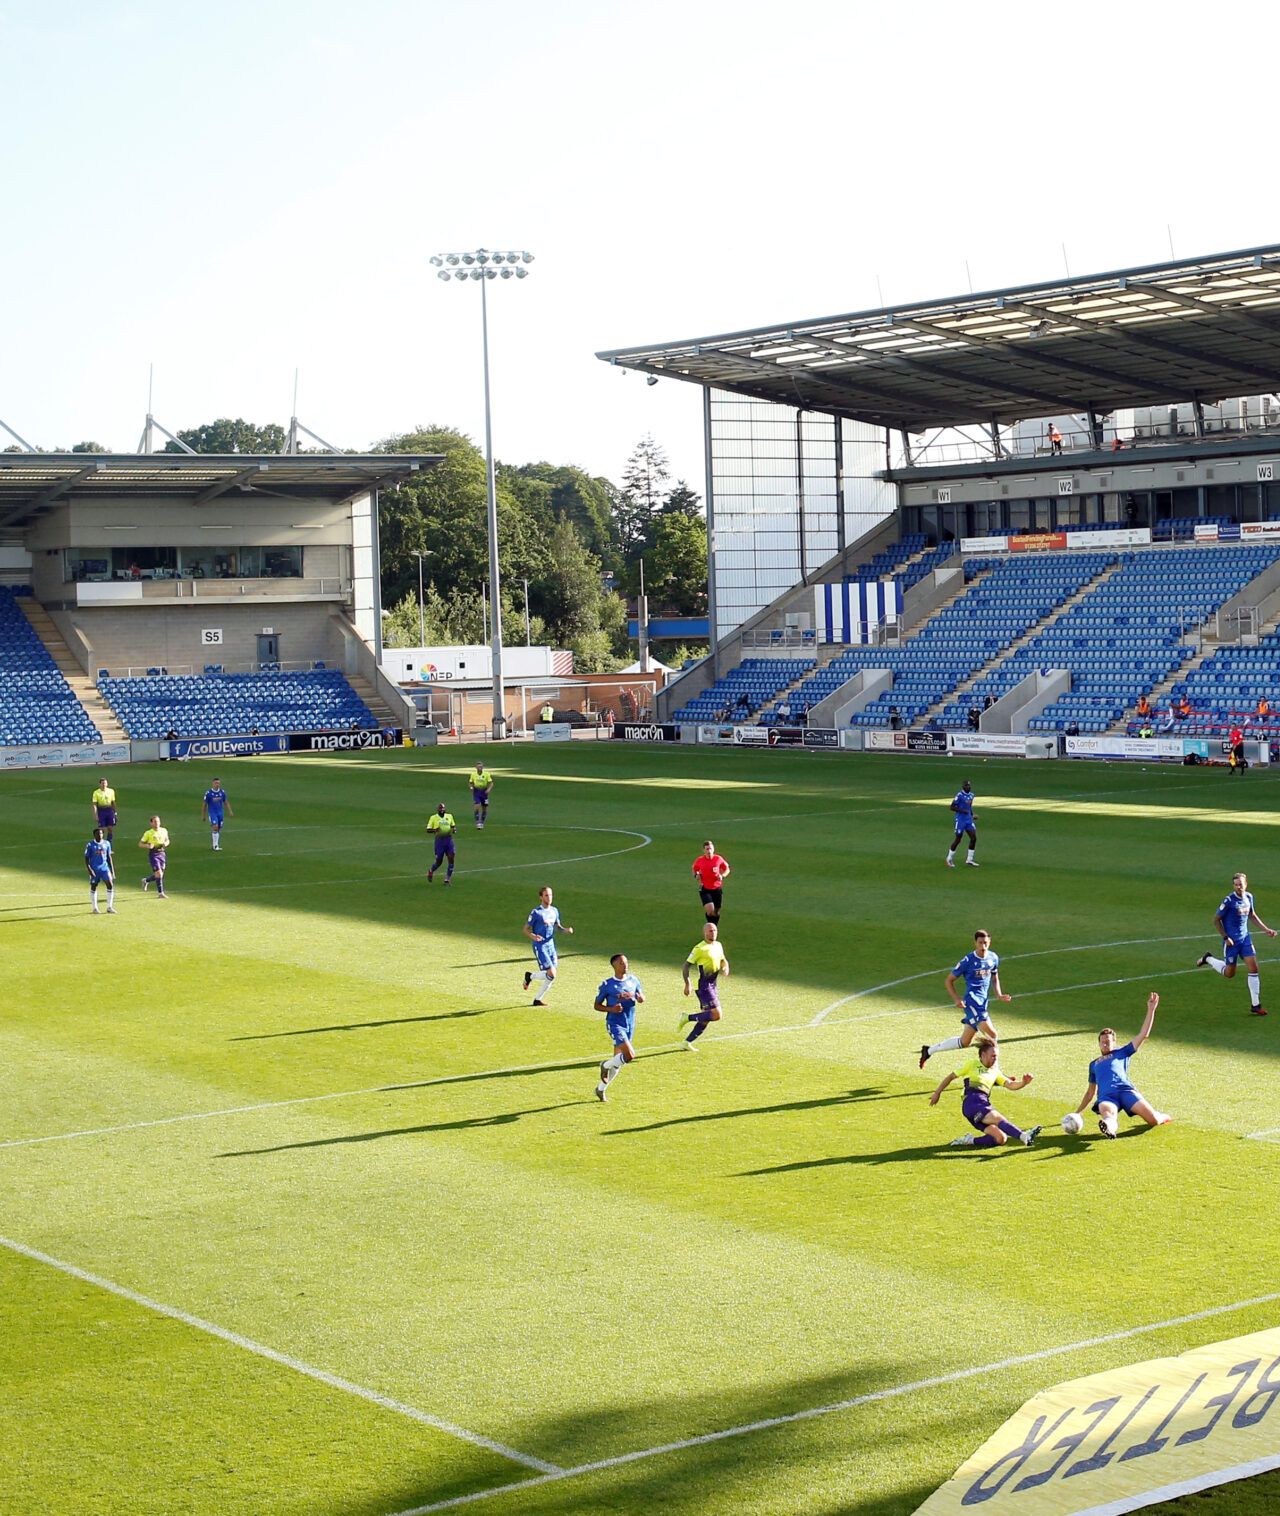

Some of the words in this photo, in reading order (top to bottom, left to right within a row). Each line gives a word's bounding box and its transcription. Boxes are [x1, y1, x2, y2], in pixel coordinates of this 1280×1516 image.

[1258, 467, 1272, 479] W3
[1059, 482, 1072, 493] W2
[938, 491, 950, 502] W1
[205, 631, 220, 642] S5
[625, 724, 664, 741] macron
[310, 731, 383, 749] macron
